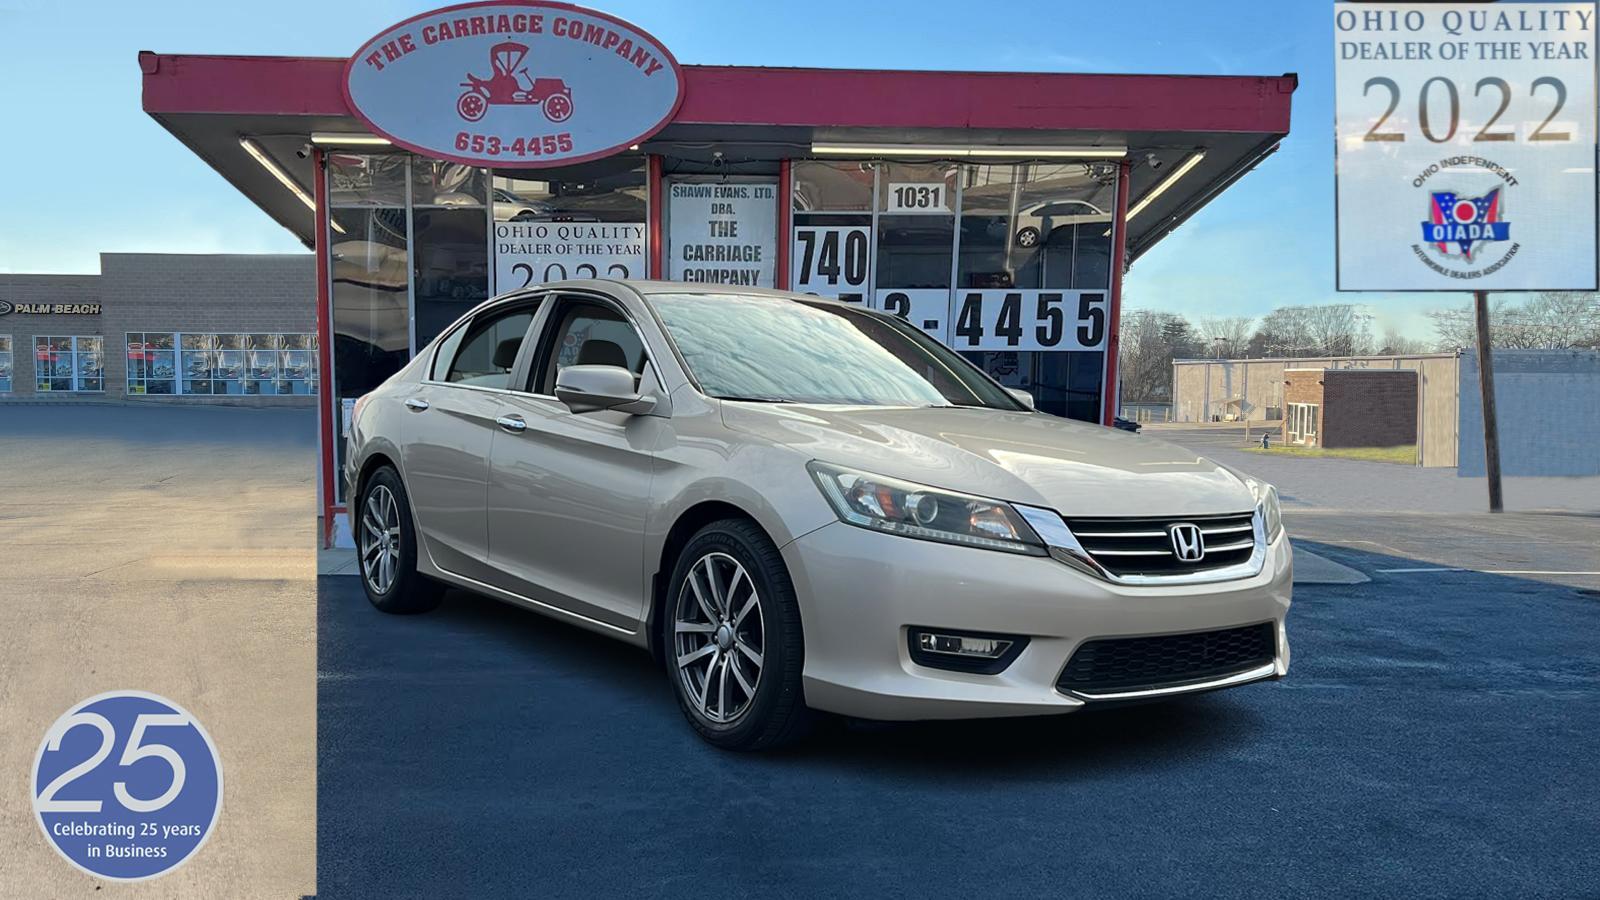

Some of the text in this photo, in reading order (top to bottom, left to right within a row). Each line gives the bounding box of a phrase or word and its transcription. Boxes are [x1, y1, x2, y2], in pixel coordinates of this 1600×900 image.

[1336, 10, 1593, 36] OHIO QUALITY
[366, 14, 663, 77] THE CARRIAGE COMPANY
[1340, 42, 1589, 60] DEALER OF THE YEAR
[1363, 76, 1570, 143] 2022
[455, 132, 573, 156] 653-4455
[1412, 156, 1519, 188] OHIO INDEPENDENT
[672, 186, 712, 198] SHAWN
[754, 187, 775, 200] LTD.
[894, 187, 941, 208] 1031
[711, 203, 736, 215] DBA.
[497, 226, 644, 241] OHIO QUALITY
[708, 220, 738, 237] THE
[1432, 224, 1495, 241] OIADA
[499, 243, 642, 255] DEALER OF THE YEAR
[683, 244, 762, 262] CARRIAGE
[798, 231, 867, 285] 740
[683, 268, 760, 287] COMPANY
[15, 304, 100, 314] PALM BEACH
